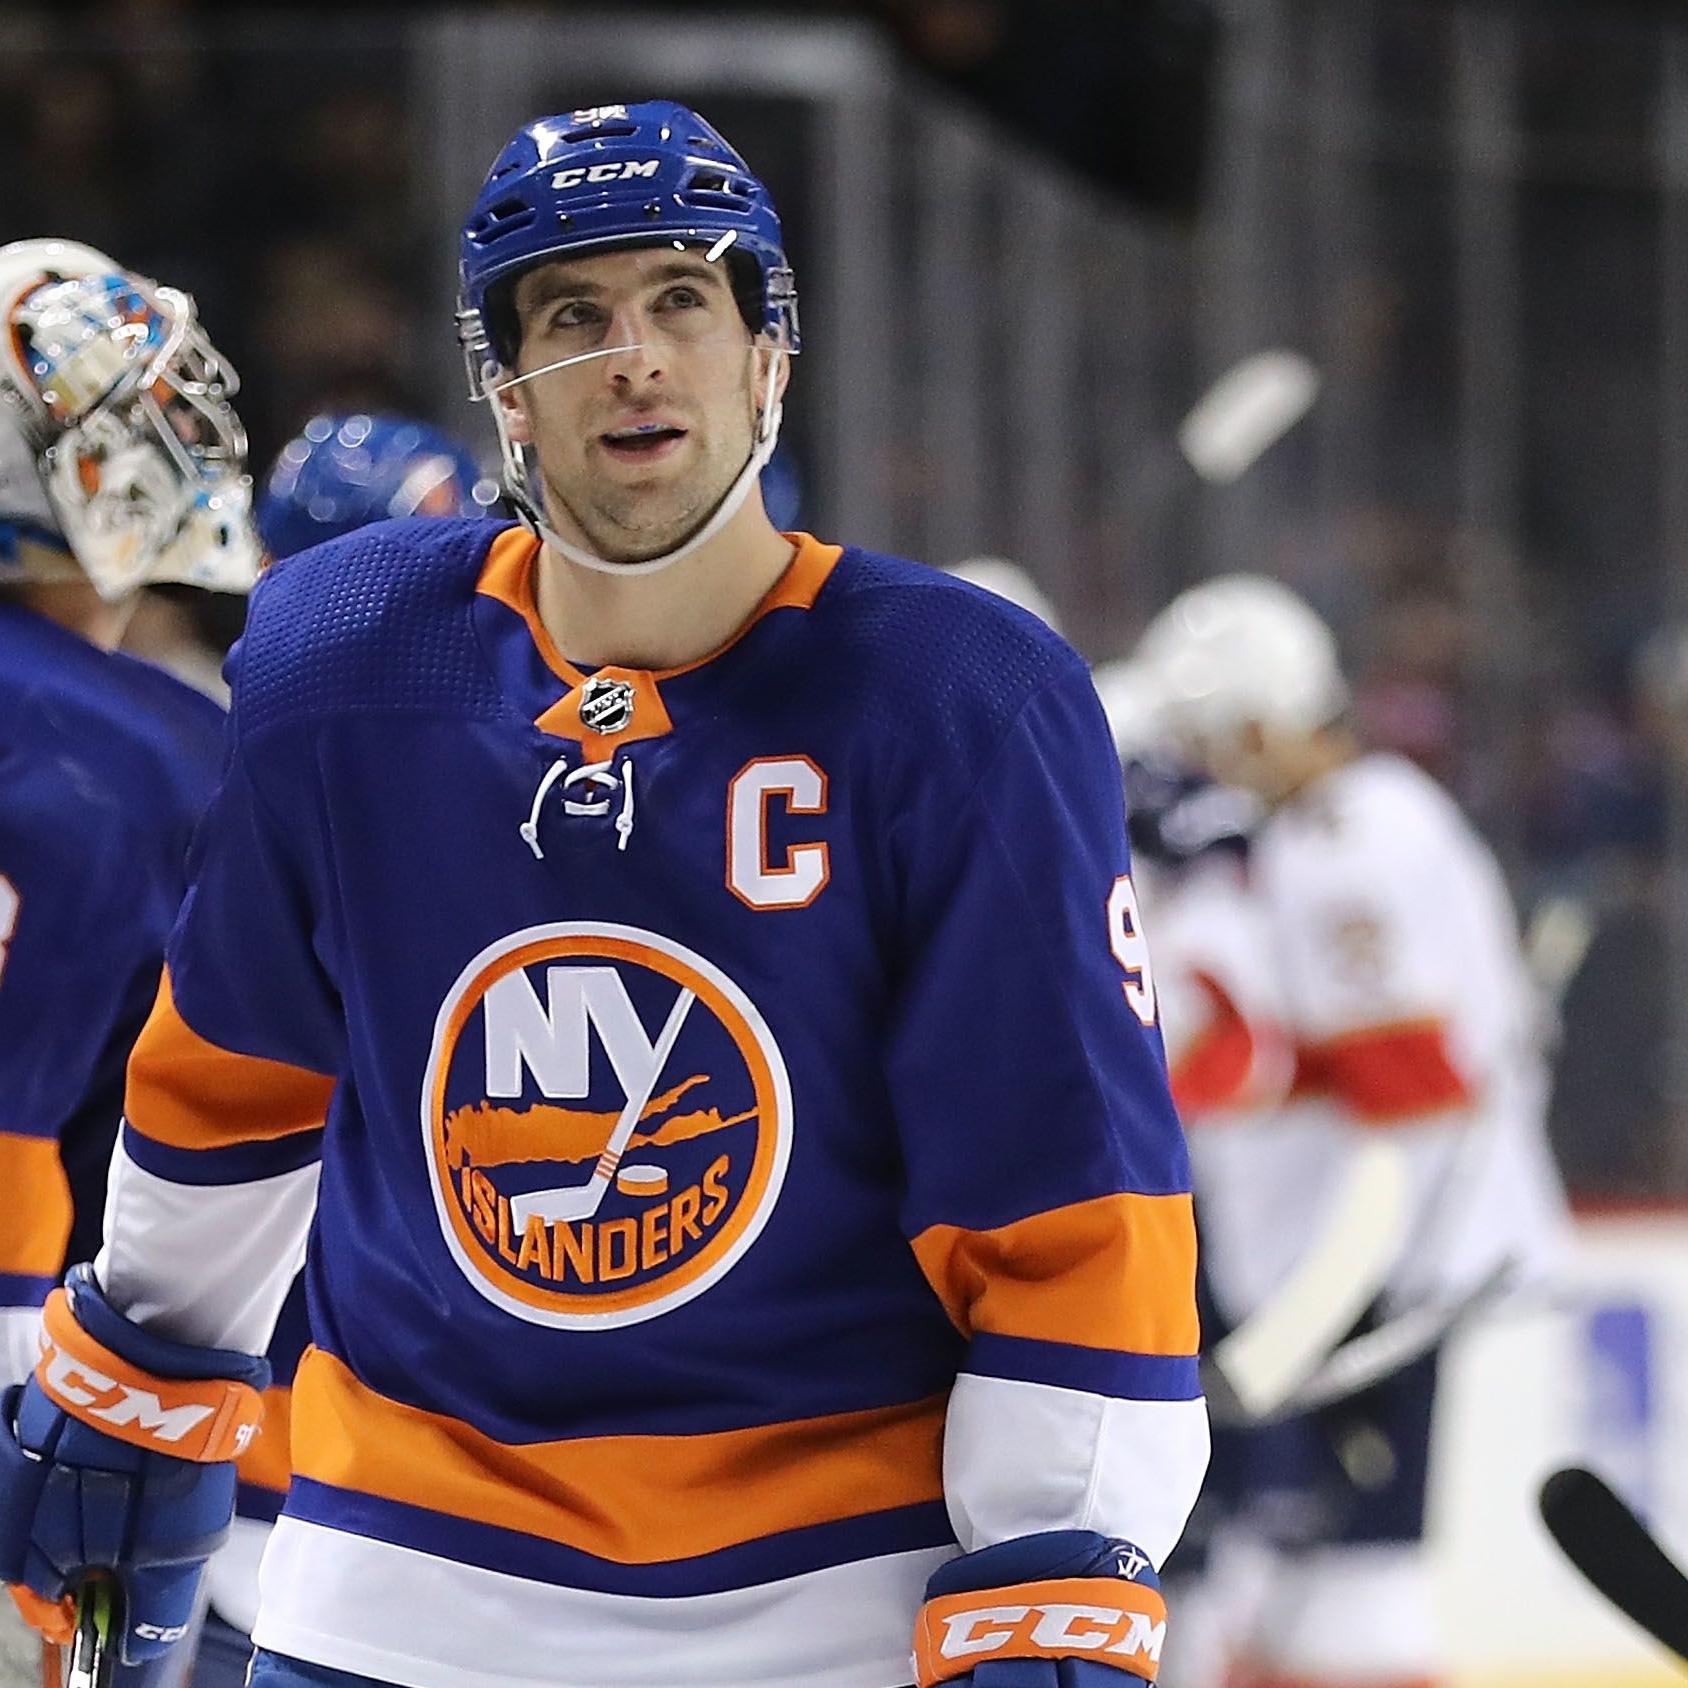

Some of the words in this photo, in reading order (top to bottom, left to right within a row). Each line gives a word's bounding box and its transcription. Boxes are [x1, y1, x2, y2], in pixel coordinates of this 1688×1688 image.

[551, 159, 660, 190] CCM
[724, 752, 831, 912] C
[1105, 873, 1156, 1027] 9
[483, 965, 698, 1106] NY
[460, 1154, 731, 1284] ISLANDERS
[40, 1328, 215, 1442] CM
[134, 1622, 187, 1643] CC
[939, 1603, 1167, 1663] CCM
